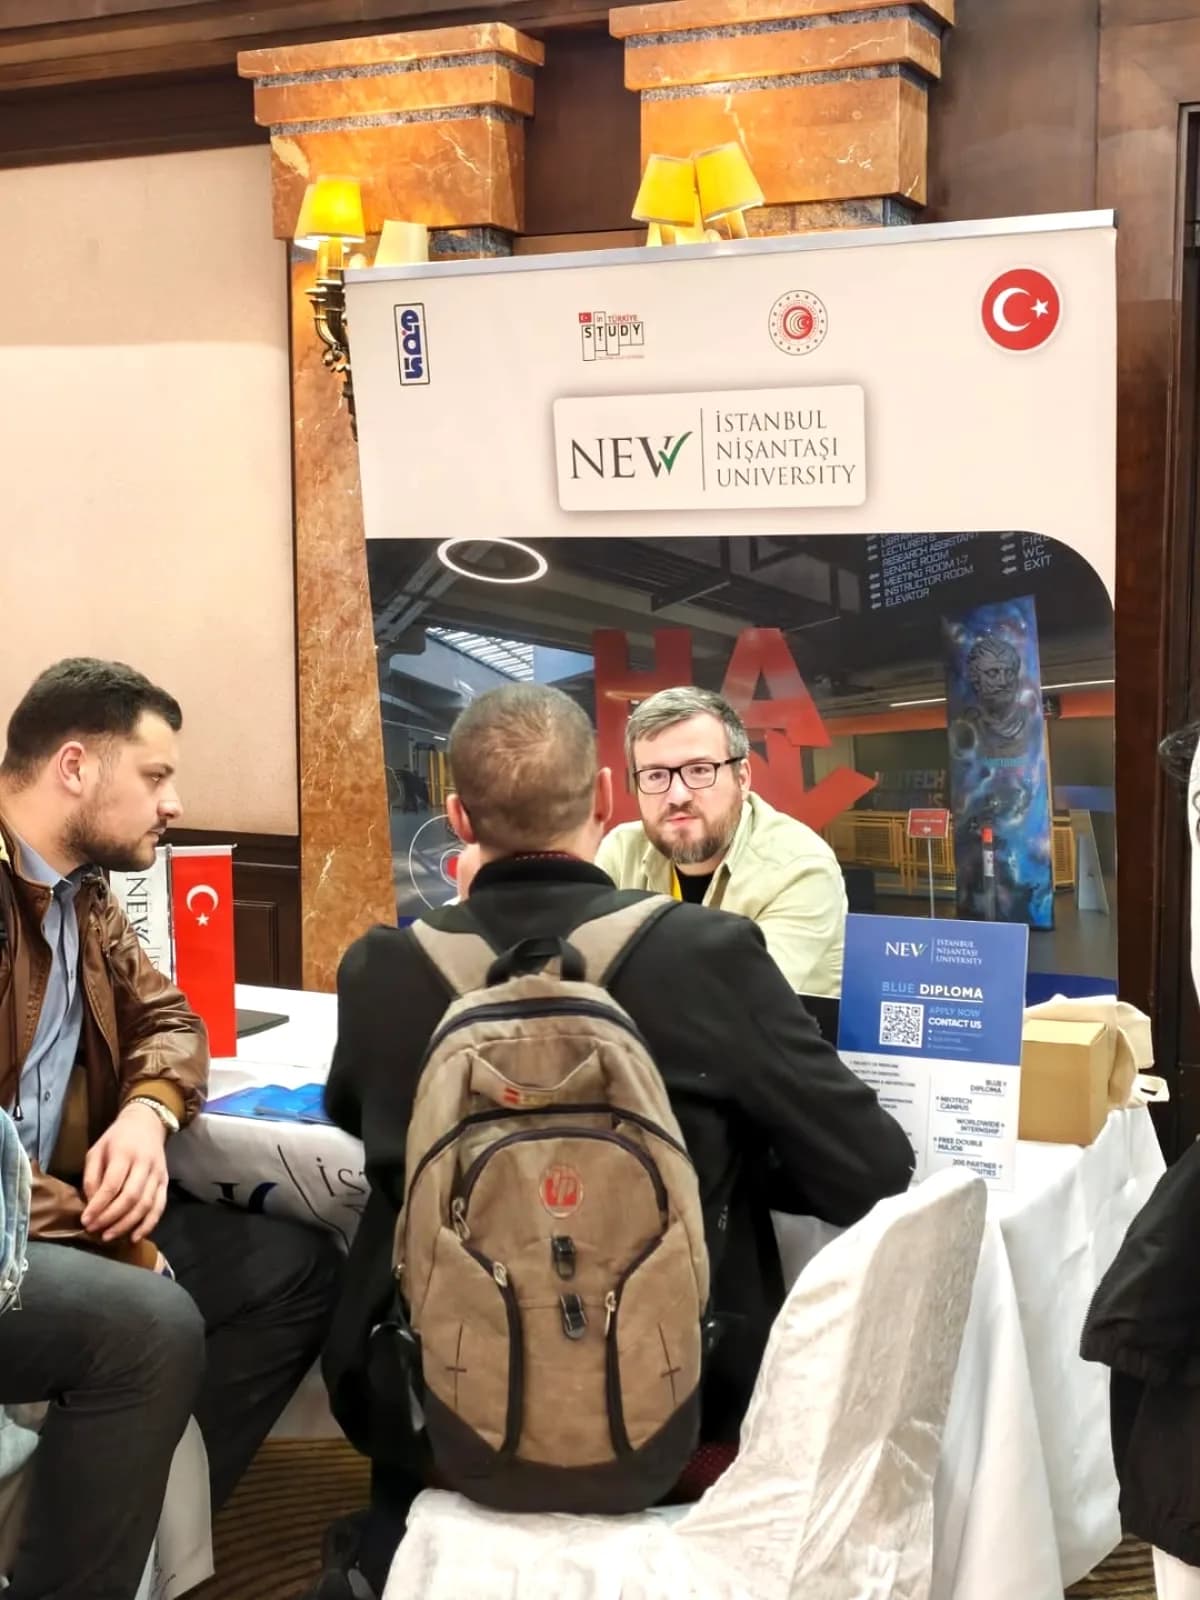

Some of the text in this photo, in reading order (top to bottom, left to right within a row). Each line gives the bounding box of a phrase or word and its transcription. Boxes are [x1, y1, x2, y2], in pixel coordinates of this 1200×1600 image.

[584, 324, 641, 341] STUDY
[715, 410, 827, 433] İSTANBUL
[716, 437, 838, 464] NİŞANTAŞI
[716, 464, 856, 488] UNIVERSITY
[920, 549, 951, 567] ROOM
[1023, 544, 1045, 559] WC
[1024, 554, 1053, 571] EXIT
[884, 568, 924, 588] MEETING
[925, 559, 955, 576] ROOM
[942, 564, 975, 581] ROOM
[886, 587, 931, 608] ELEVATOR
[881, 981, 984, 999] BLUE DIPLOMA
[928, 1017, 982, 1029] CONTACT US
